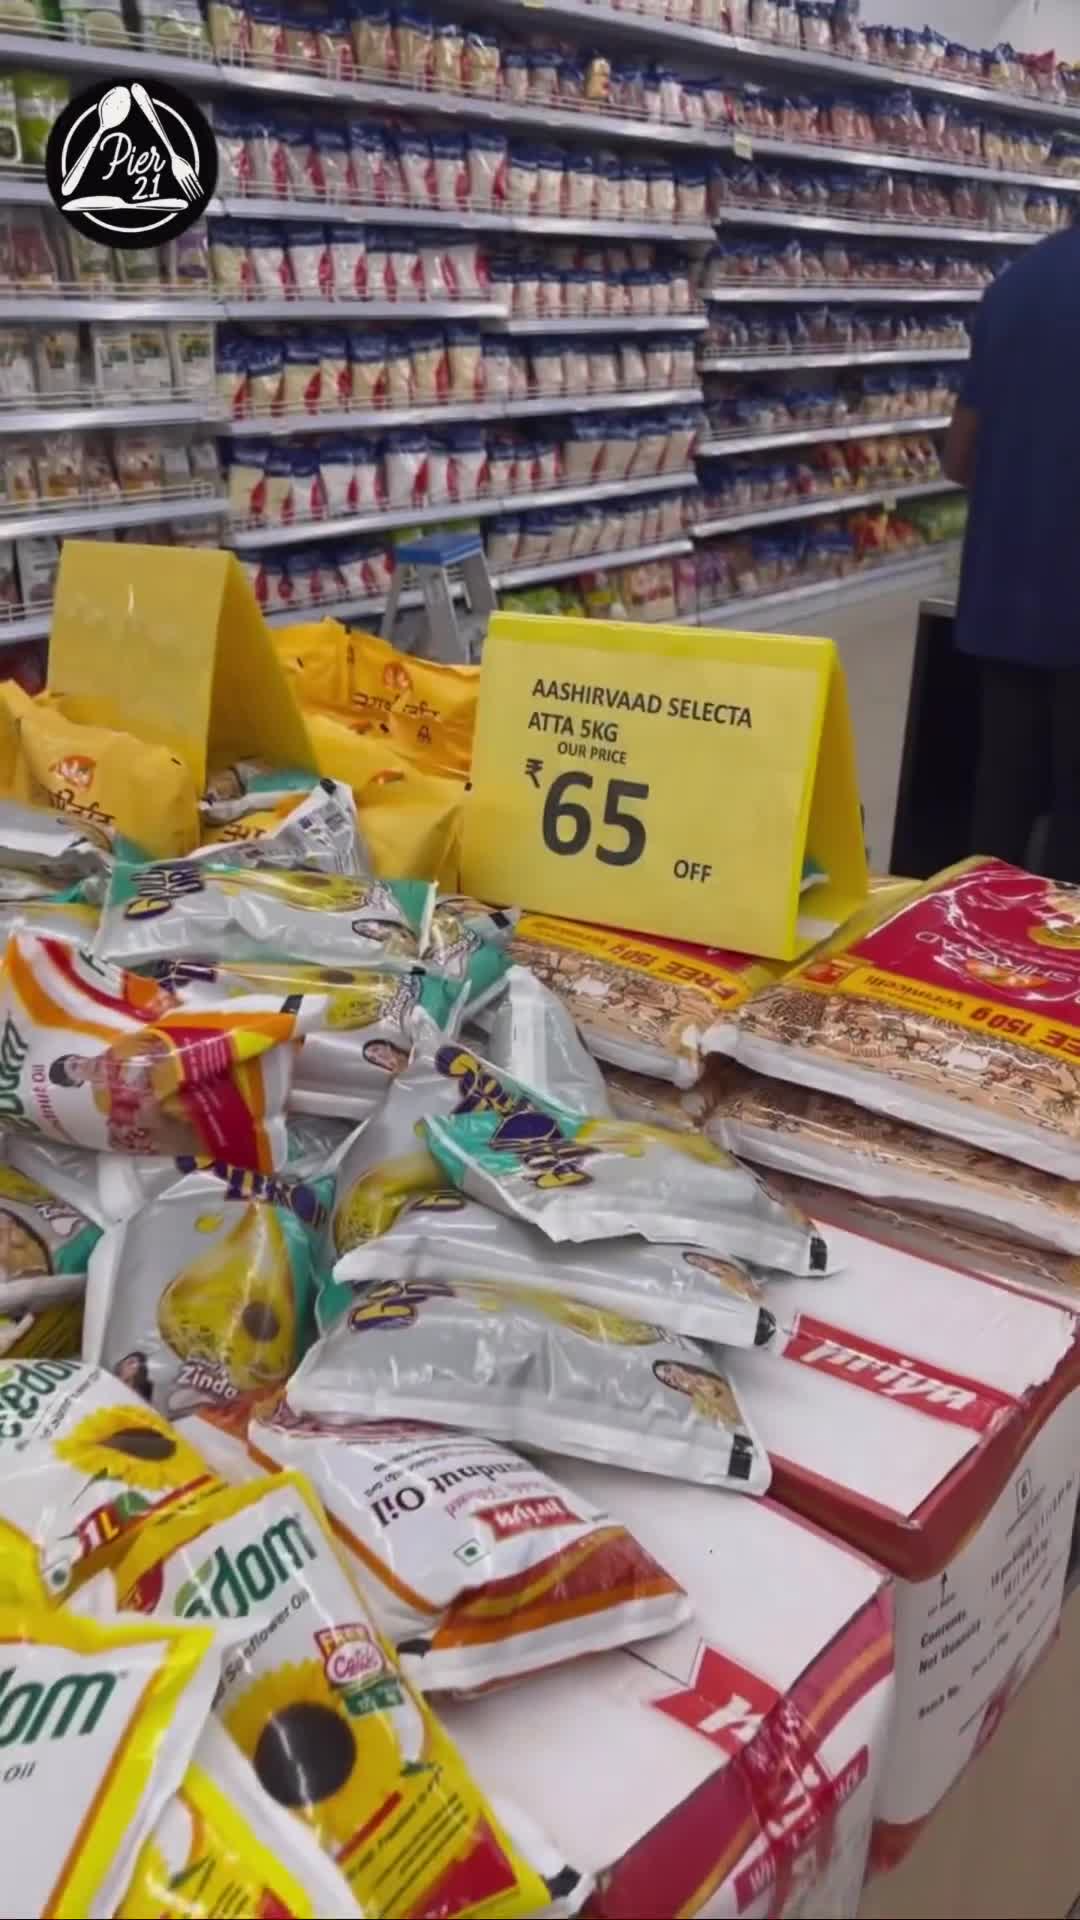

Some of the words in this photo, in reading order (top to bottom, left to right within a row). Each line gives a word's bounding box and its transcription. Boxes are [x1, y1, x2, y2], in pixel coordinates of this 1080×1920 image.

[532, 678, 662, 716] AASHIRVAAD
[667, 698, 753, 729] SELECTA
[527, 711, 575, 737] ATTA
[580, 719, 620, 744] 5KG
[557, 741, 587, 759] OUR
[590, 746, 628, 766] PRICE
[542, 770, 650, 867] 65
[673, 859, 713, 884] OFF
[800, 1338, 977, 1411] priya
[370, 1486, 426, 1528] Oil
[3, 1761, 36, 1783] Oil
